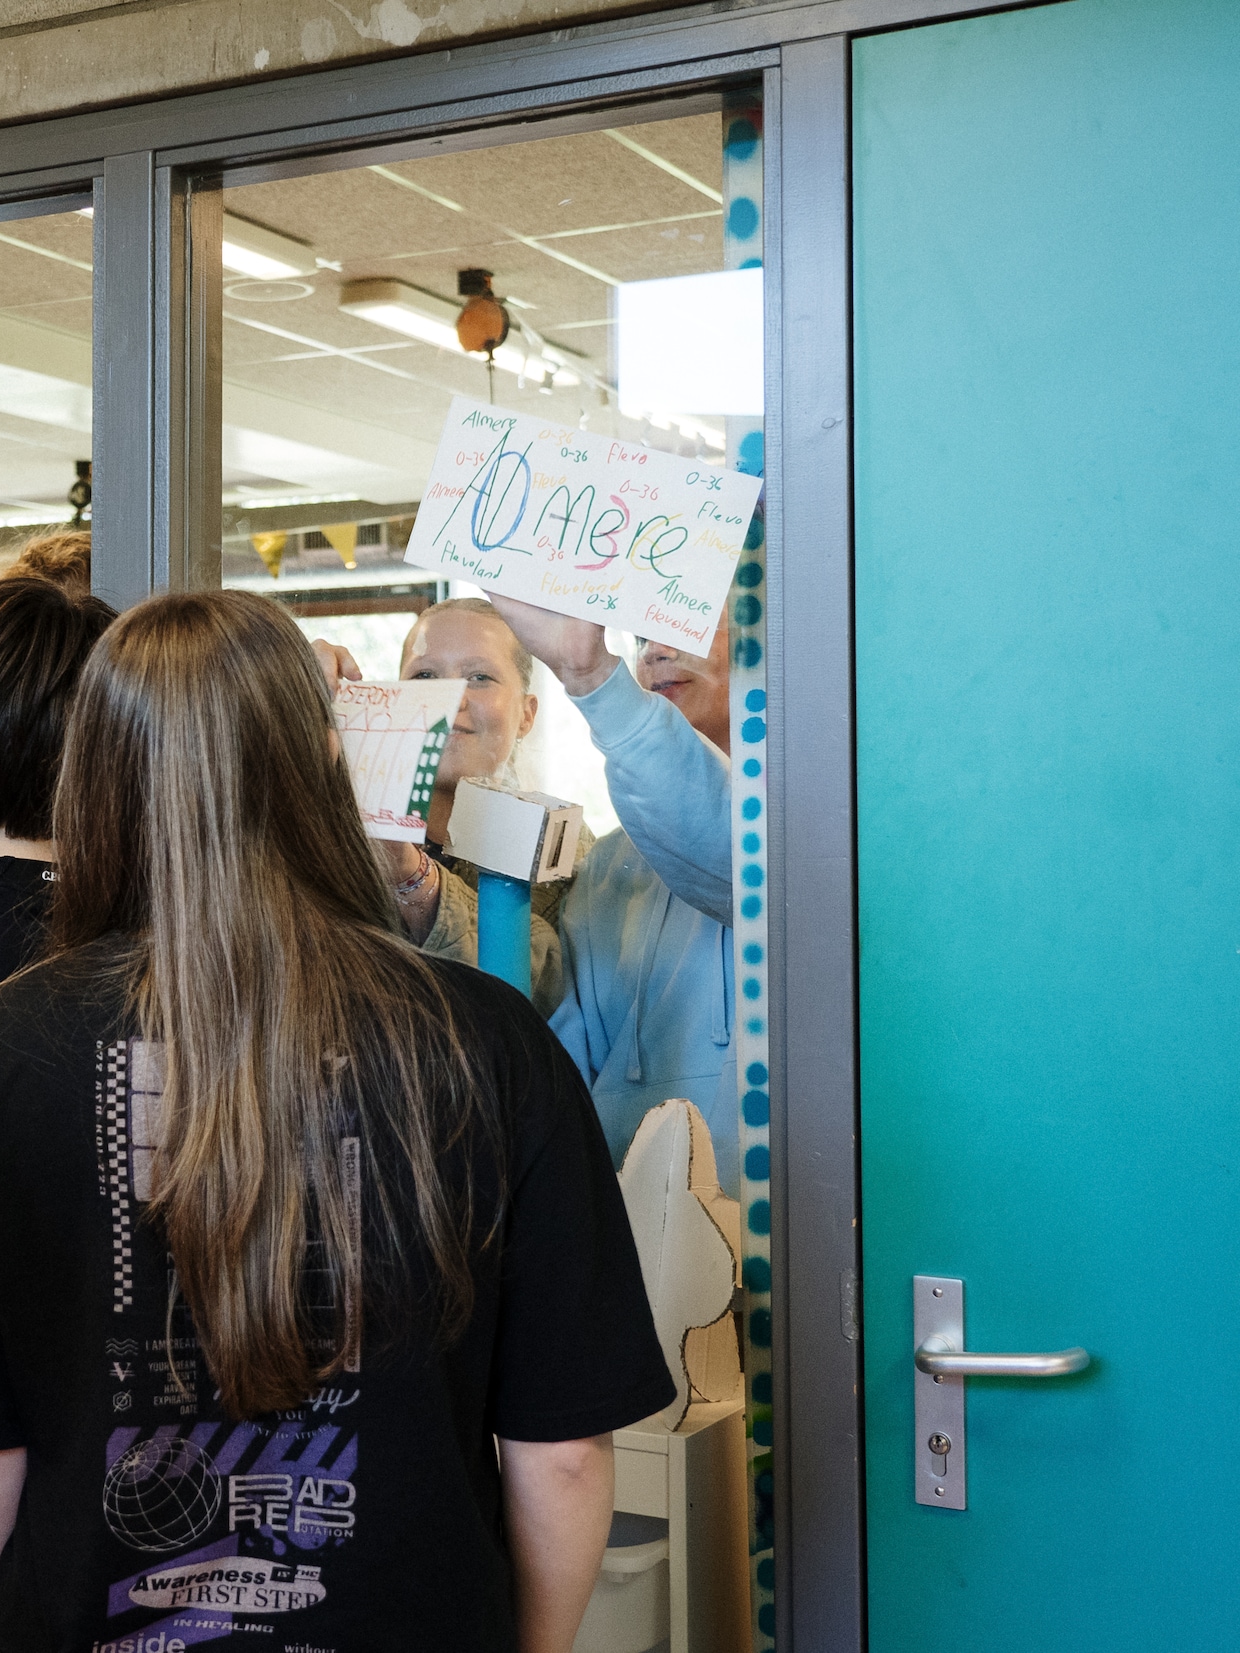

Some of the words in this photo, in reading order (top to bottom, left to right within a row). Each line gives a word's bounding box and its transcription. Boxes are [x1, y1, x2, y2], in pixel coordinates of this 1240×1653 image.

[619, 480, 659, 501] 0-36
[686, 471, 723, 491] 0-36
[274, 1410, 307, 1421] YOU
[228, 1473, 357, 1508] BAD
[132, 1568, 266, 1592] Awareness
[170, 1583, 247, 1606] FIRST
[253, 1587, 320, 1610] STEP
[173, 1618, 192, 1627] IN
[195, 1620, 275, 1633] HEALING
[92, 1631, 186, 1653] inside
